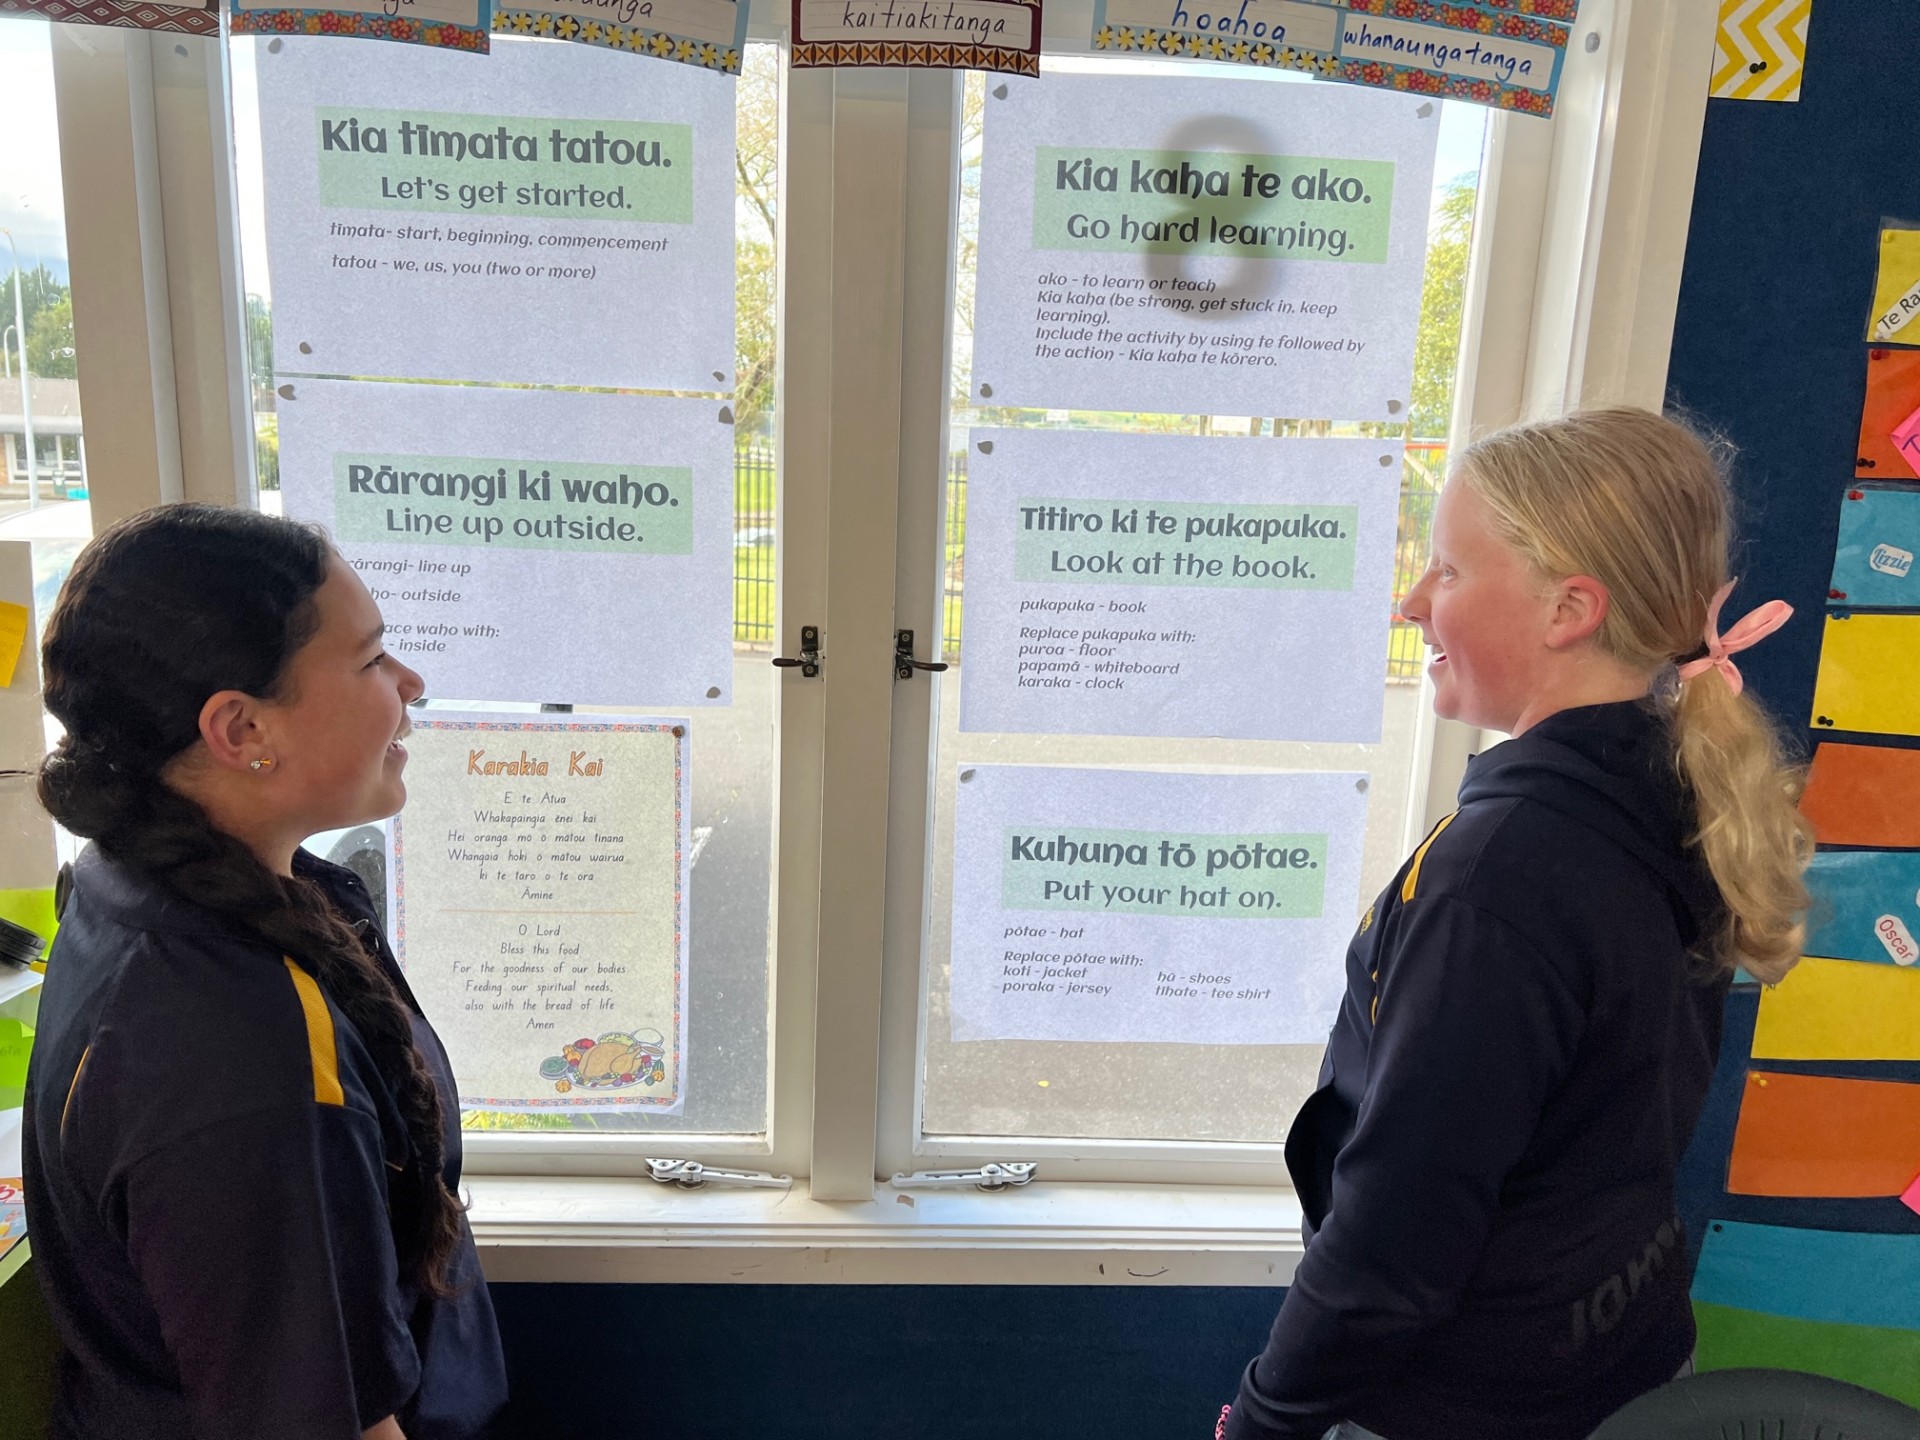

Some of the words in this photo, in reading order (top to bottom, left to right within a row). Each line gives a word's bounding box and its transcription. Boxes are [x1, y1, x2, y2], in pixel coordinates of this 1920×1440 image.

[842, 0, 1006, 45] kaitiakitanga
[1171, 0, 1287, 43] hoahoa
[1343, 23, 1533, 81] whanaungatanga
[321, 117, 388, 154] Kia
[397, 120, 538, 163] tīmata
[548, 129, 672, 168] tatou.
[1056, 157, 1119, 192] Kia
[1130, 160, 1230, 200] kaha
[1241, 164, 1281, 199] te
[1291, 168, 1372, 204] ako.
[458, 180, 508, 210] get
[516, 182, 632, 210] started.
[330, 222, 392, 238] tīmata-
[396, 225, 442, 242] start,
[537, 235, 669, 252] commencement
[1067, 213, 1111, 240] Go
[1121, 214, 1200, 243] hard
[1209, 215, 1354, 257] learning.
[332, 254, 377, 269] tatou
[393, 260, 419, 273] we,
[424, 261, 447, 274] us,
[452, 263, 482, 277] you
[486, 261, 522, 276] (two
[525, 266, 545, 277] or
[548, 265, 596, 280] more)
[1037, 272, 1068, 286] ako
[1082, 273, 1099, 287] to
[1102, 274, 1145, 290] learn
[1148, 279, 1169, 290] or
[1170, 277, 1216, 294] teach
[1037, 290, 1063, 304] Kia
[1065, 291, 1106, 307] kaha
[1109, 292, 1135, 307] (be
[1199, 297, 1228, 313] get
[1229, 297, 1274, 312] stuck
[1299, 300, 1338, 319] keep
[1877, 311, 1901, 332] Te
[1899, 287, 1920, 314] Ra
[1036, 307, 1111, 327] learning).
[1035, 326, 1094, 341] Include
[1097, 328, 1123, 344] the
[1126, 330, 1186, 349] activity
[1188, 332, 1209, 350] by
[1210, 336, 1255, 351] using
[1258, 334, 1274, 348] te
[1277, 334, 1345, 351] followed
[1346, 338, 1366, 356] by
[1035, 343, 1061, 359] the
[1064, 346, 1115, 361] action
[1128, 348, 1154, 362] Kia
[1157, 349, 1197, 364] kaha
[1201, 350, 1217, 364] te
[1220, 351, 1277, 367] kōrero.
[348, 464, 507, 507] Rārangi
[518, 469, 551, 502] ki
[561, 473, 679, 510] waho.
[386, 507, 453, 536] Line
[462, 516, 504, 543] up
[512, 514, 644, 543] outside.
[1020, 505, 1103, 533] Titiro
[1111, 508, 1138, 534] ki
[1145, 509, 1178, 535] te
[1184, 512, 1347, 545] pukapuka.
[418, 559, 448, 574] line
[450, 564, 471, 578] up
[1051, 550, 1124, 574] Look
[1132, 551, 1166, 575] at
[1172, 552, 1224, 579] the
[1232, 554, 1316, 579] book.
[1871, 548, 1911, 571] Lizzie
[401, 588, 461, 603] outside
[1019, 598, 1095, 615] pukapuka
[1108, 600, 1147, 613] book
[416, 623, 459, 637] waho
[463, 624, 500, 639] with:
[1019, 626, 1079, 642] Replace
[1081, 628, 1157, 644] pukapuka
[1161, 630, 1196, 644] with:
[398, 638, 446, 652] inside
[1018, 645, 1065, 658] puroa
[1078, 642, 1117, 657] floor
[1094, 660, 1180, 675] whiteboard
[1018, 675, 1072, 688] karaka
[1084, 676, 1125, 690] clock
[467, 750, 548, 776] Karakia
[568, 750, 604, 777] Kai
[540, 791, 567, 804] Atua
[473, 810, 546, 829] Whakapaingia
[582, 811, 597, 823] kai
[447, 829, 465, 842] Hei
[474, 834, 508, 848] oranga
[594, 832, 624, 843] tinana
[507, 849, 528, 862] hoki
[589, 854, 625, 862] wairua
[1011, 835, 1148, 868] Kuhuna
[1157, 840, 1197, 869] tō
[1205, 842, 1318, 877] pōtae.
[515, 870, 536, 881] taro
[577, 873, 594, 881] ora
[1044, 879, 1095, 901] Put
[1101, 885, 1172, 908] your
[1179, 885, 1231, 910] hat
[1238, 890, 1282, 911] on.
[518, 923, 528, 936] O
[536, 924, 561, 937] Lord
[1059, 927, 1084, 939] hat
[1879, 919, 1914, 959] Oscar
[500, 941, 525, 955] Bless
[533, 942, 550, 955] this
[558, 942, 580, 956] food
[1003, 950, 1061, 965] Replace
[1109, 954, 1144, 967] with:
[452, 960, 472, 974] For
[480, 960, 495, 973] the
[503, 961, 545, 979] goodness
[571, 966, 589, 974] our
[597, 961, 626, 974] bodies
[1003, 964, 1032, 977] koti
[1041, 965, 1087, 980] jacket
[1188, 972, 1232, 985] shoes
[465, 979, 503, 997] Feeding
[510, 984, 529, 992] our
[537, 979, 577, 997] spiritual
[1001, 980, 1055, 994] poraka
[1065, 981, 1112, 997] jersey
[1211, 987, 1234, 999] tee
[1236, 988, 1271, 1000] shirt
[464, 998, 484, 1011] also
[492, 998, 514, 1011] with
[522, 998, 537, 1011] the
[545, 997, 573, 1011] bread
[599, 997, 615, 1010] life
[525, 1017, 555, 1030] Amen
